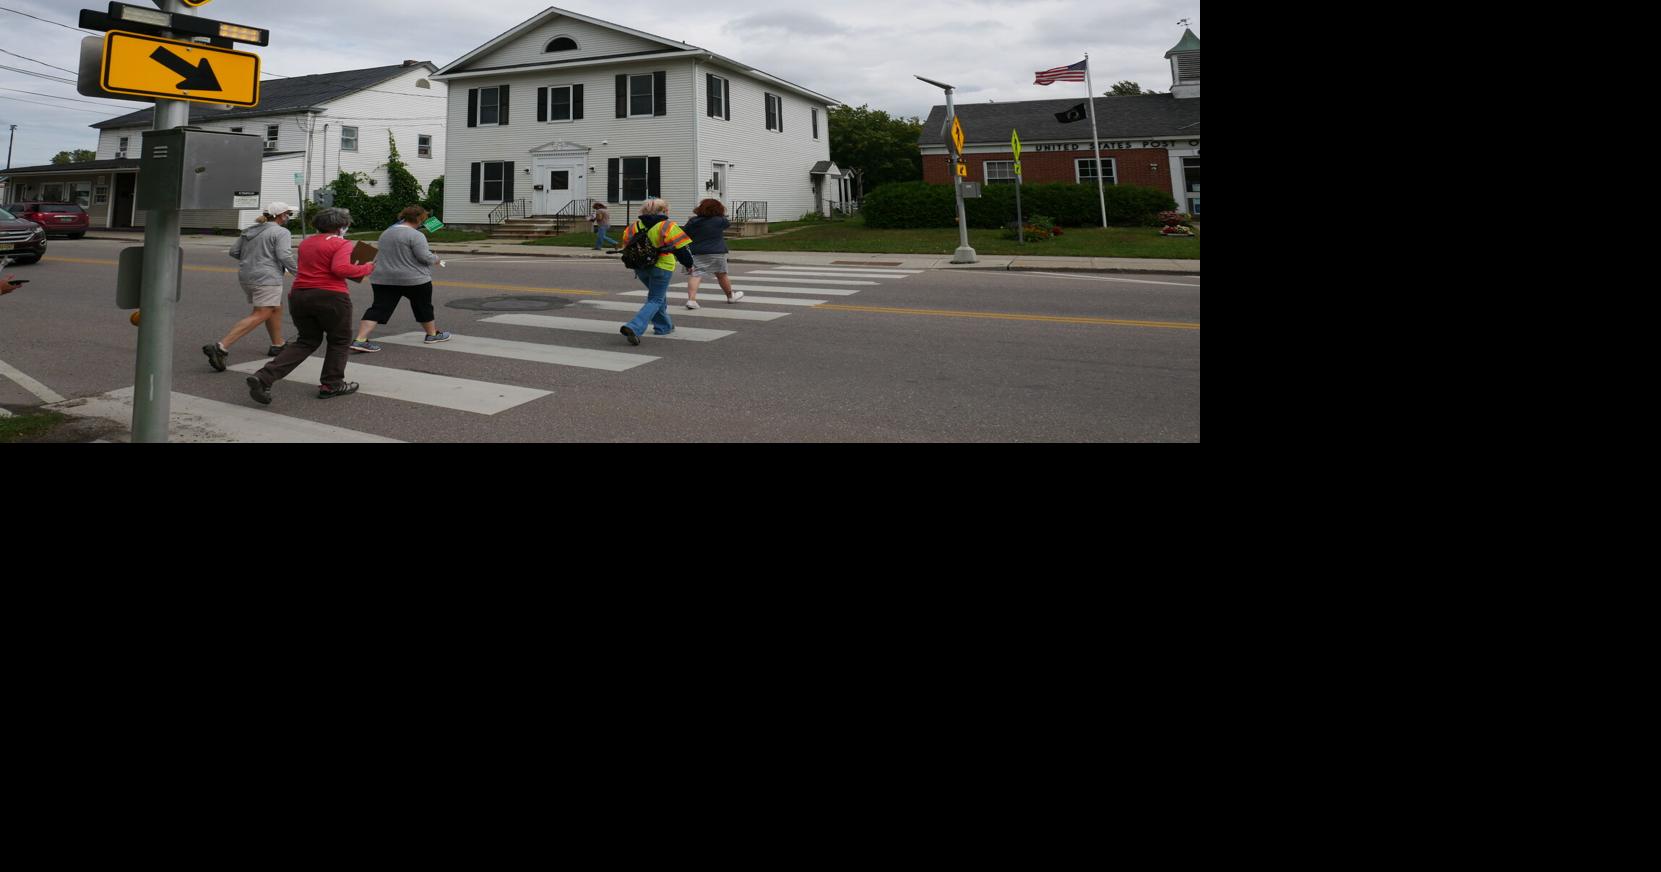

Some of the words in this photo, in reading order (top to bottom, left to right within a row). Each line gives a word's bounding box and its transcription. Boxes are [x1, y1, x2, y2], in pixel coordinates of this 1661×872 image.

[1035, 143, 1079, 151] UNITED
[1089, 141, 1132, 150] STATES
[1142, 140, 1176, 148] POST
